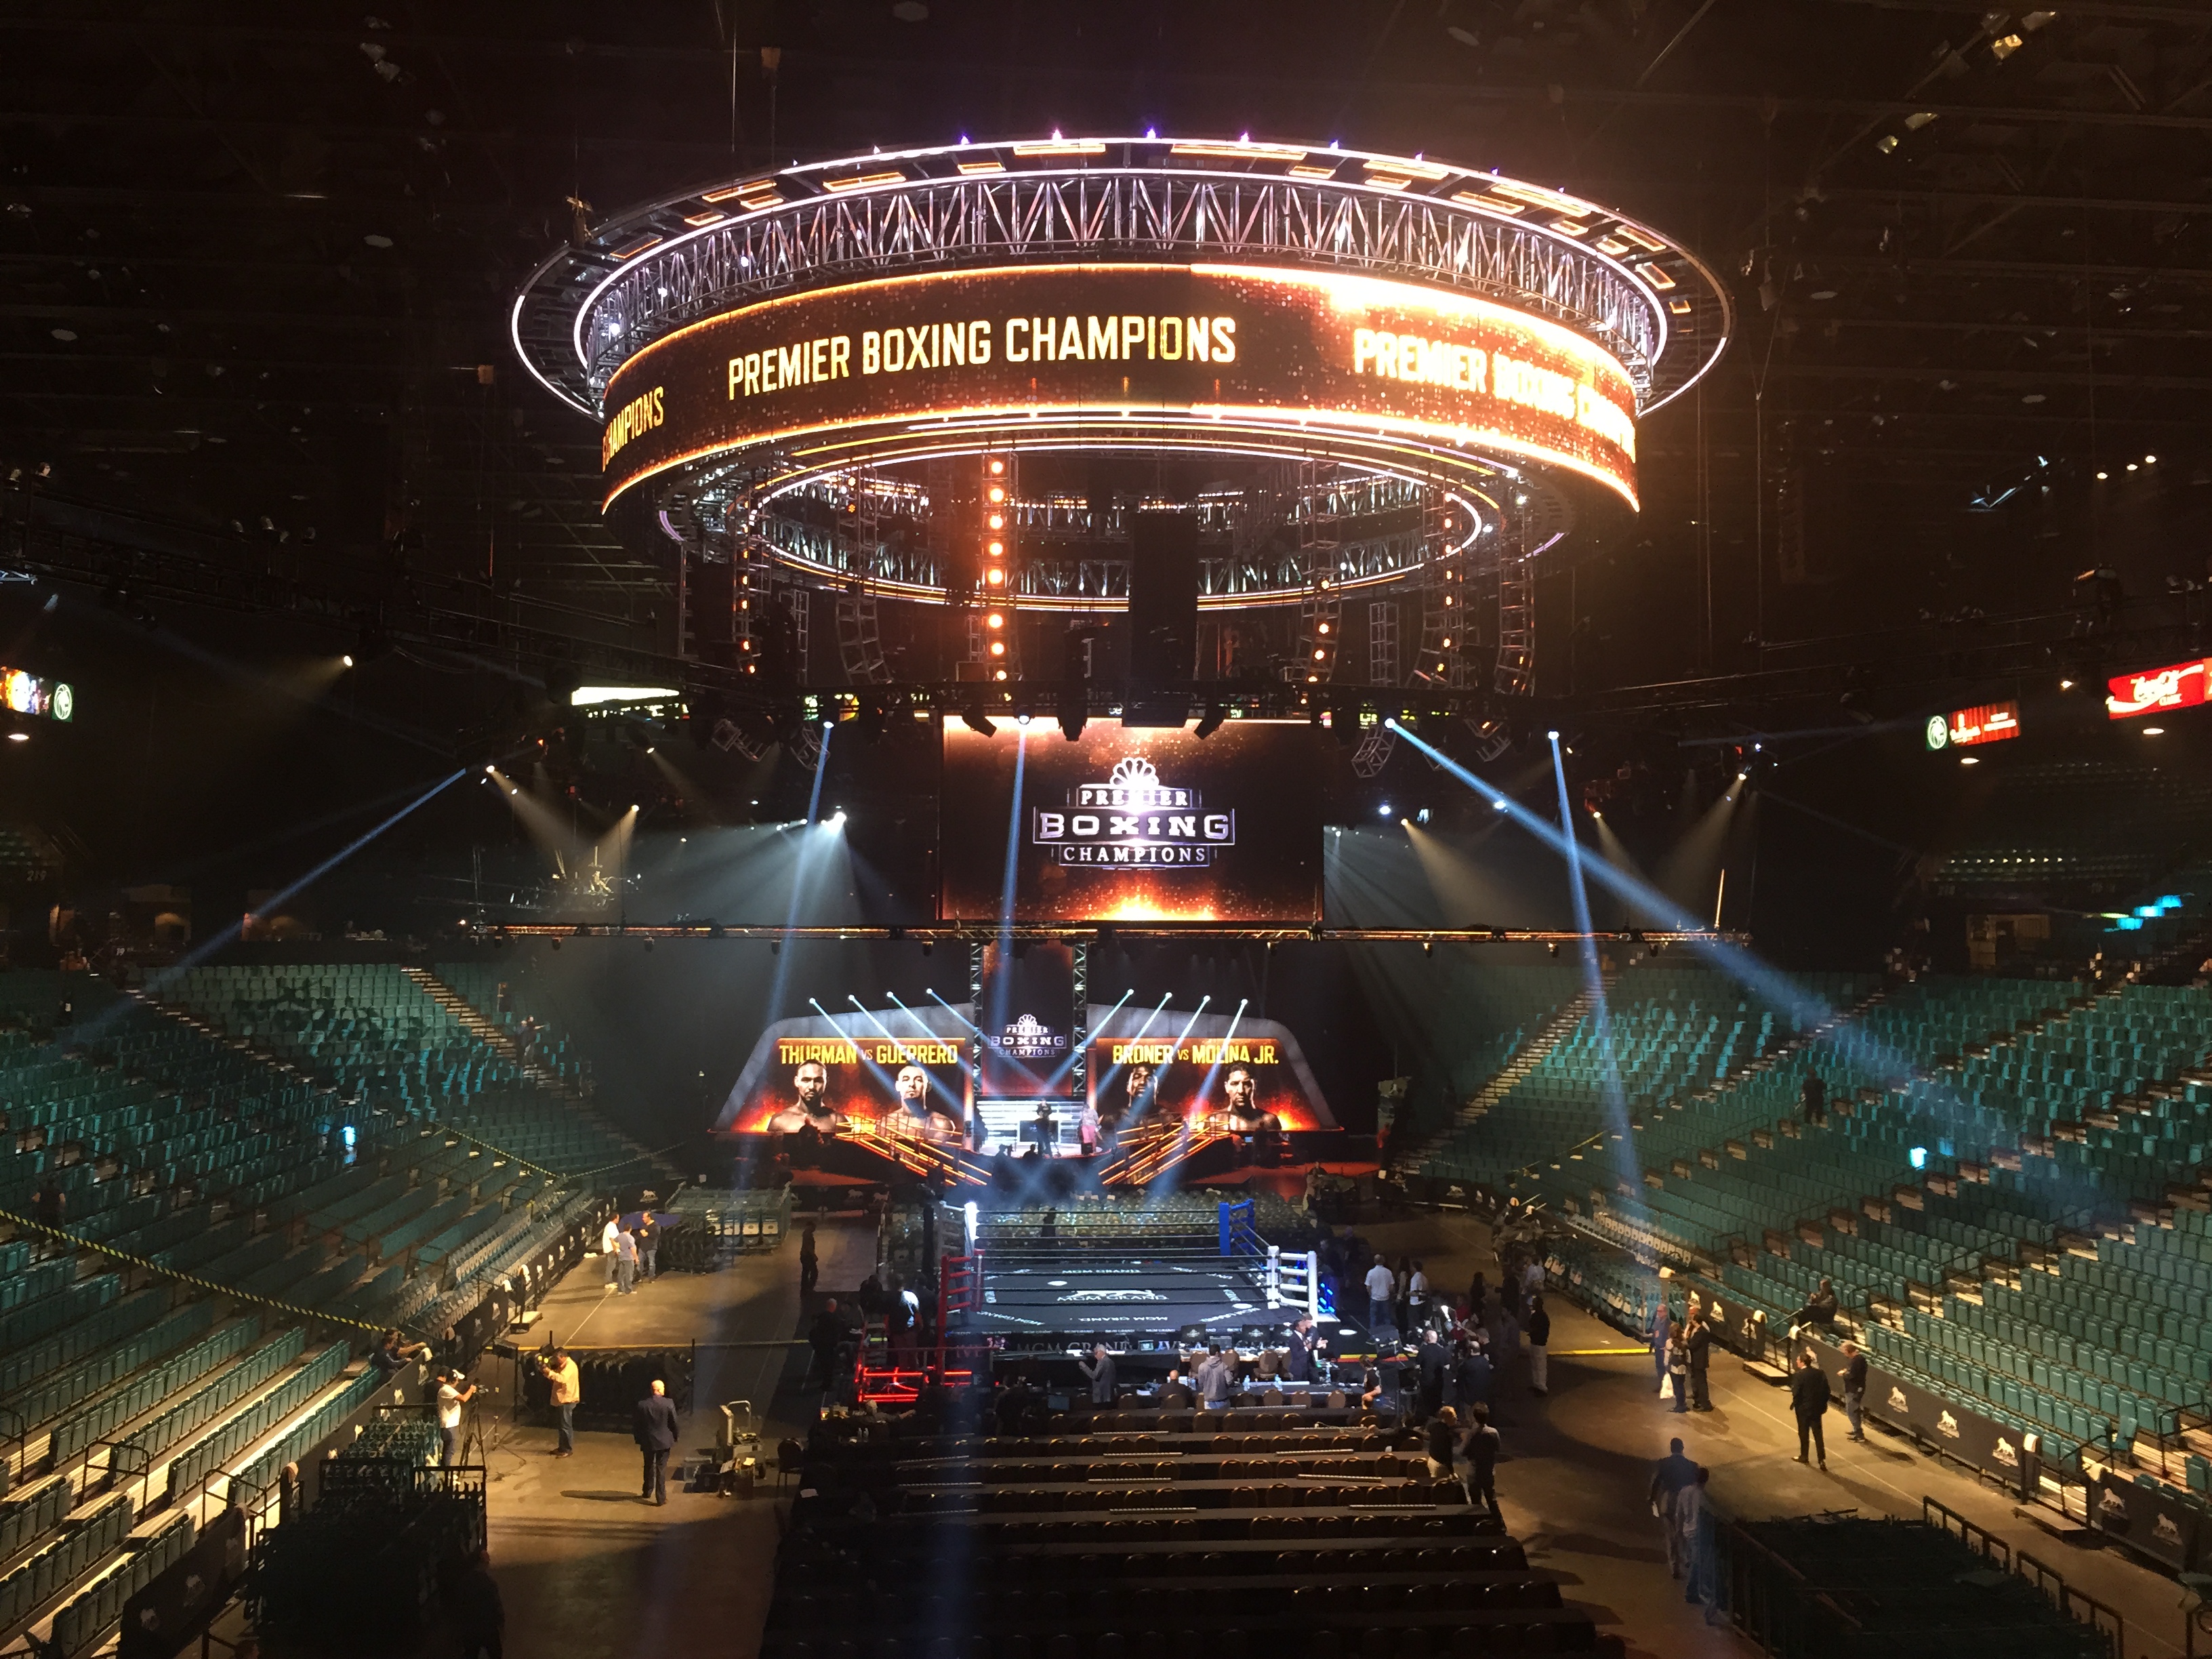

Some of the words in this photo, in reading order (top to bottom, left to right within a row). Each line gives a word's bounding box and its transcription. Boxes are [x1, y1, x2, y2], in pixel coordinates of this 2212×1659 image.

[729, 335, 850, 401] PREMIER
[863, 321, 991, 375] BOXING
[1006, 316, 1235, 363] CHAMPIONS
[1353, 328, 1487, 394] PREMIER
[1040, 813, 1229, 840] BOXING
[1063, 847, 1205, 862] CHAMPIONS
[990, 1036, 1065, 1046] BOXING
[779, 1045, 858, 1064] THURMAN
[876, 1044, 958, 1064] GUERRERO
[1113, 1045, 1174, 1064] BRONER
[1192, 1045, 1250, 1064] MOLINA
[1254, 1045, 1279, 1064] JR.
[1067, 1340, 1127, 1353] GRND
